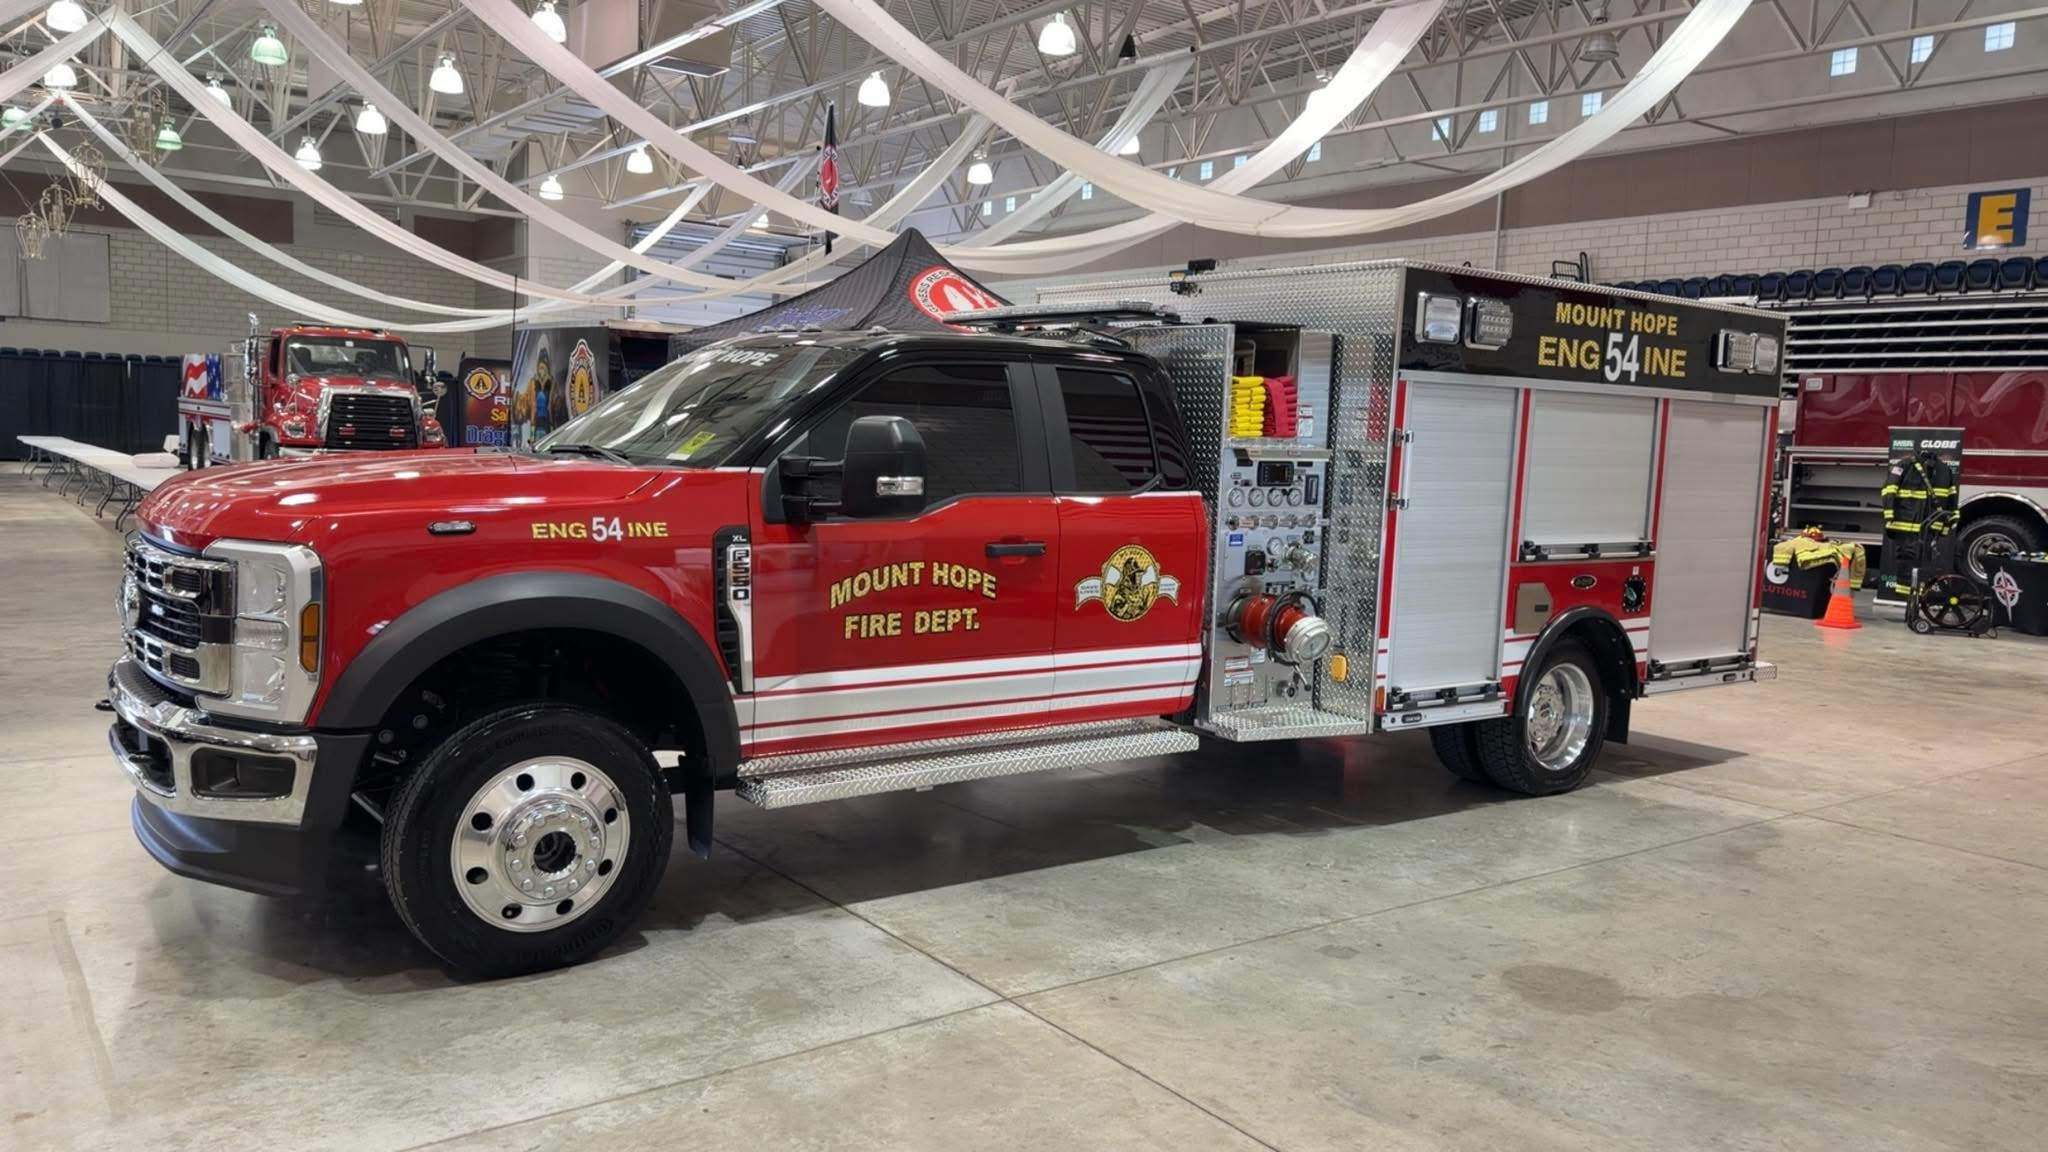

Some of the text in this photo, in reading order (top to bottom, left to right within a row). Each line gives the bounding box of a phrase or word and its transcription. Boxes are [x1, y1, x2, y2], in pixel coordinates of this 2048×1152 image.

[1976, 193, 2017, 246] E
[917, 282, 939, 314] GENESIS
[1555, 302, 1678, 336] MOUNT HOPE
[717, 350, 779, 367] HOPE
[1538, 332, 1687, 383] ENG 54 INE
[1920, 439, 1958, 449] GLOBE
[531, 516, 668, 542] ENG 54 INE
[830, 562, 997, 609] MOUNT HOPE
[844, 608, 980, 640] FIRE DEPT.
